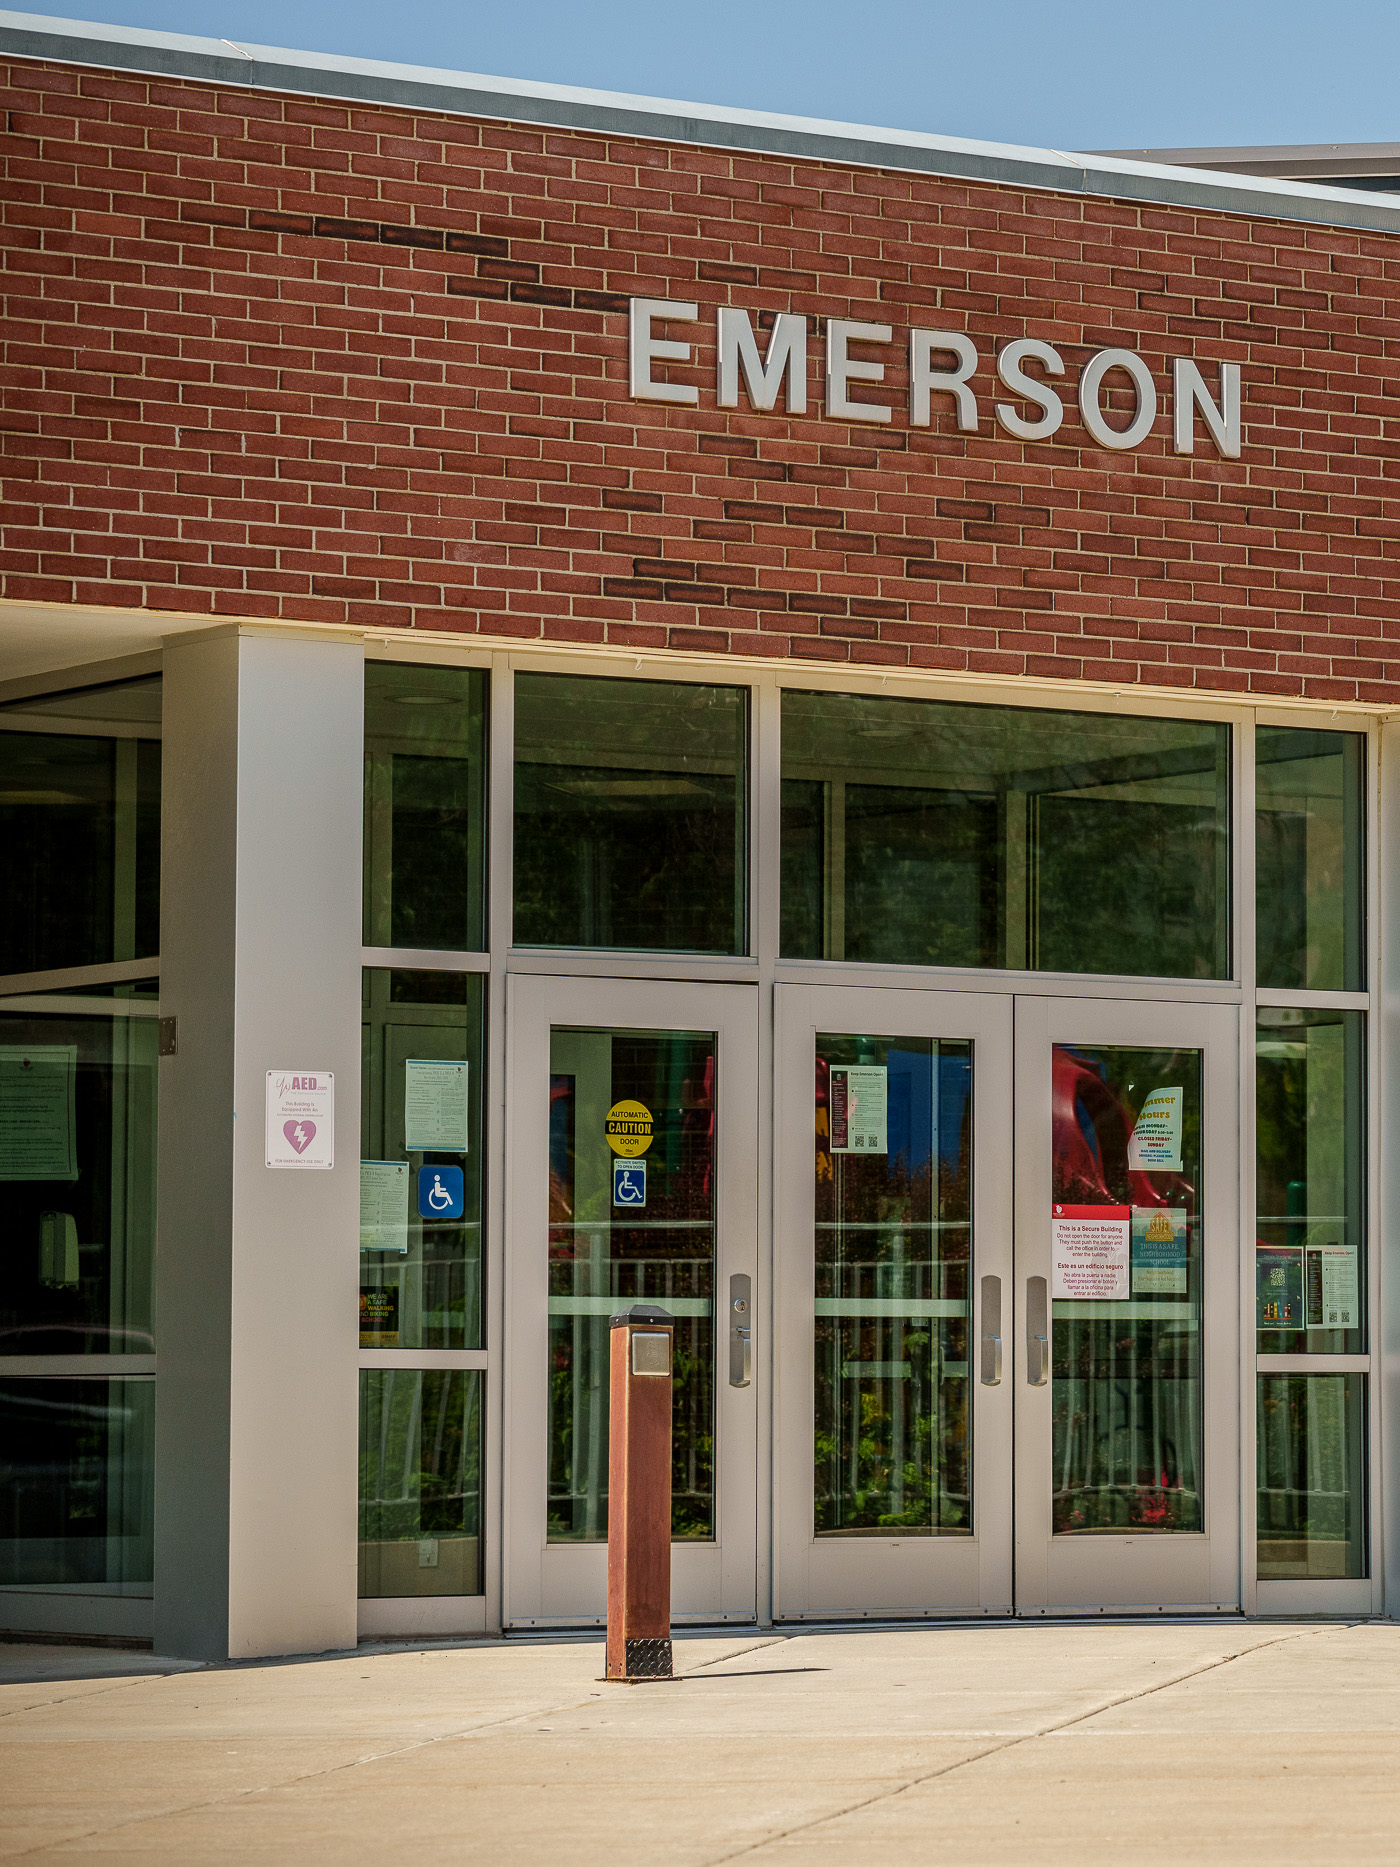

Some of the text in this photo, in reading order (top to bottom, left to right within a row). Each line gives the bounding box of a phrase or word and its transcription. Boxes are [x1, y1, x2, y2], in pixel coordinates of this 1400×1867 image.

[629, 297, 1242, 459] EMERSON
[1144, 1096, 1176, 1107] mmer
[608, 1122, 651, 1134] CAUTION
[1151, 1217, 1168, 1232] SAFE
